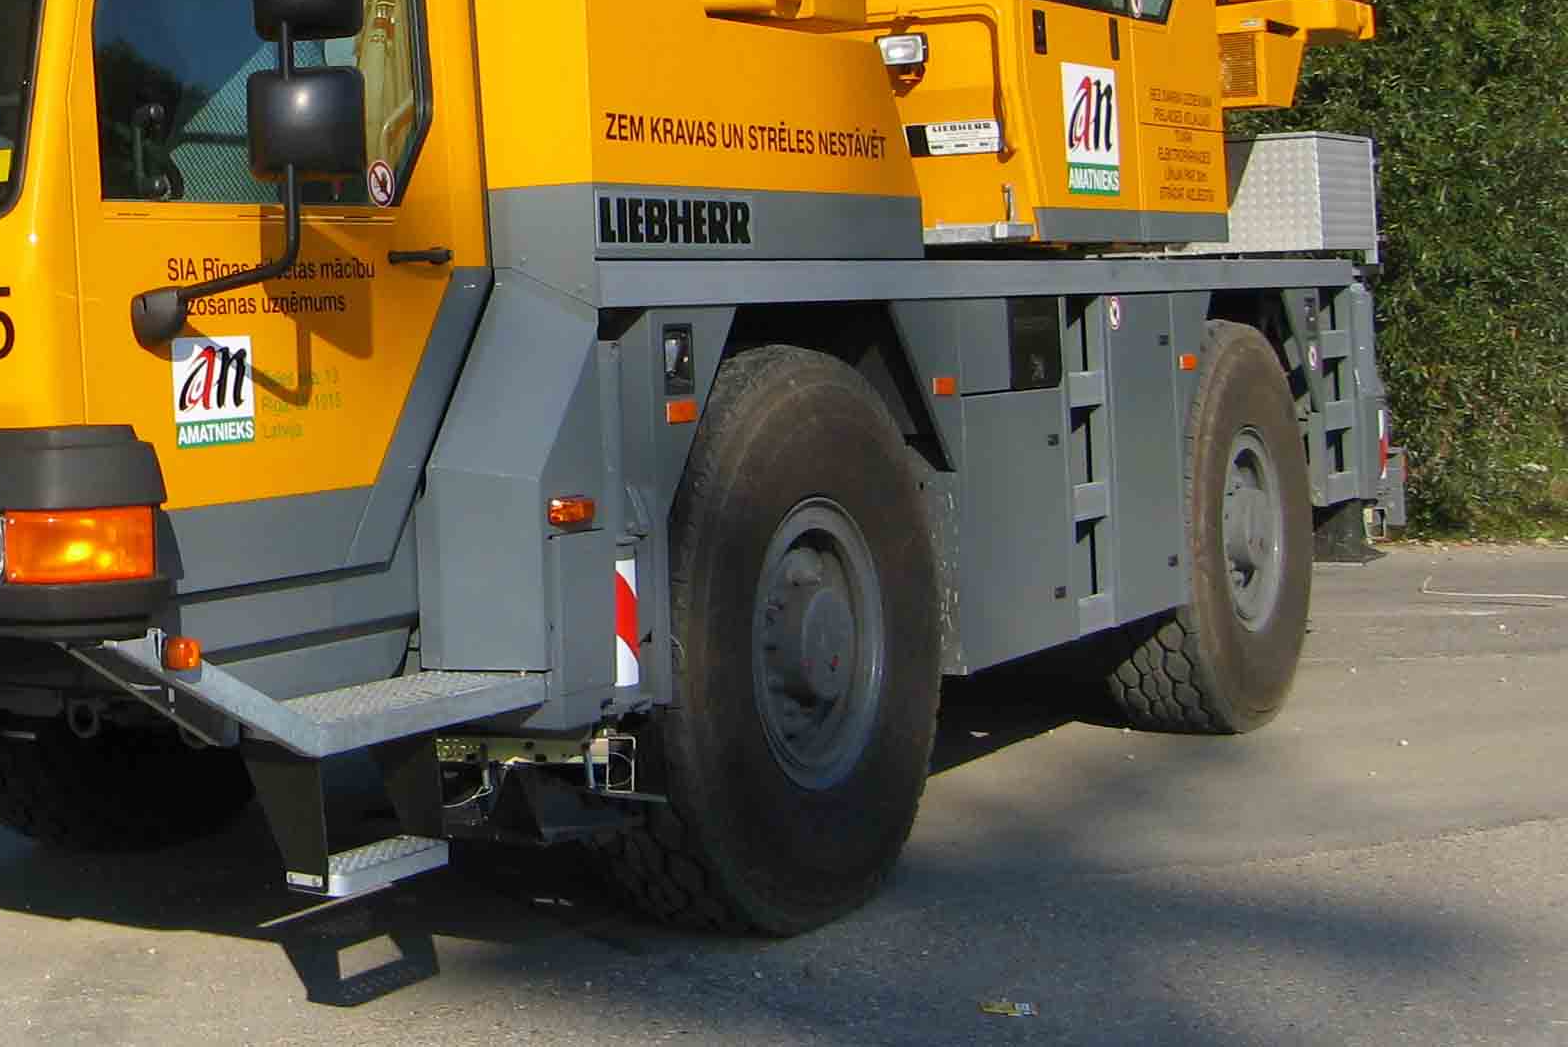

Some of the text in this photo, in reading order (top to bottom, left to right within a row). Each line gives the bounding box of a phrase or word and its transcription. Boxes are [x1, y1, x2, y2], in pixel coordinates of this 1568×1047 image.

[605, 112, 644, 142] ZEM
[650, 117, 717, 148] KRAVAS
[721, 123, 743, 149] UN
[1068, 167, 1120, 191] AMATNIEKS
[599, 196, 752, 245] LIEBHERR
[167, 258, 198, 281] SIA
[178, 420, 254, 445] AMATNIEKS
